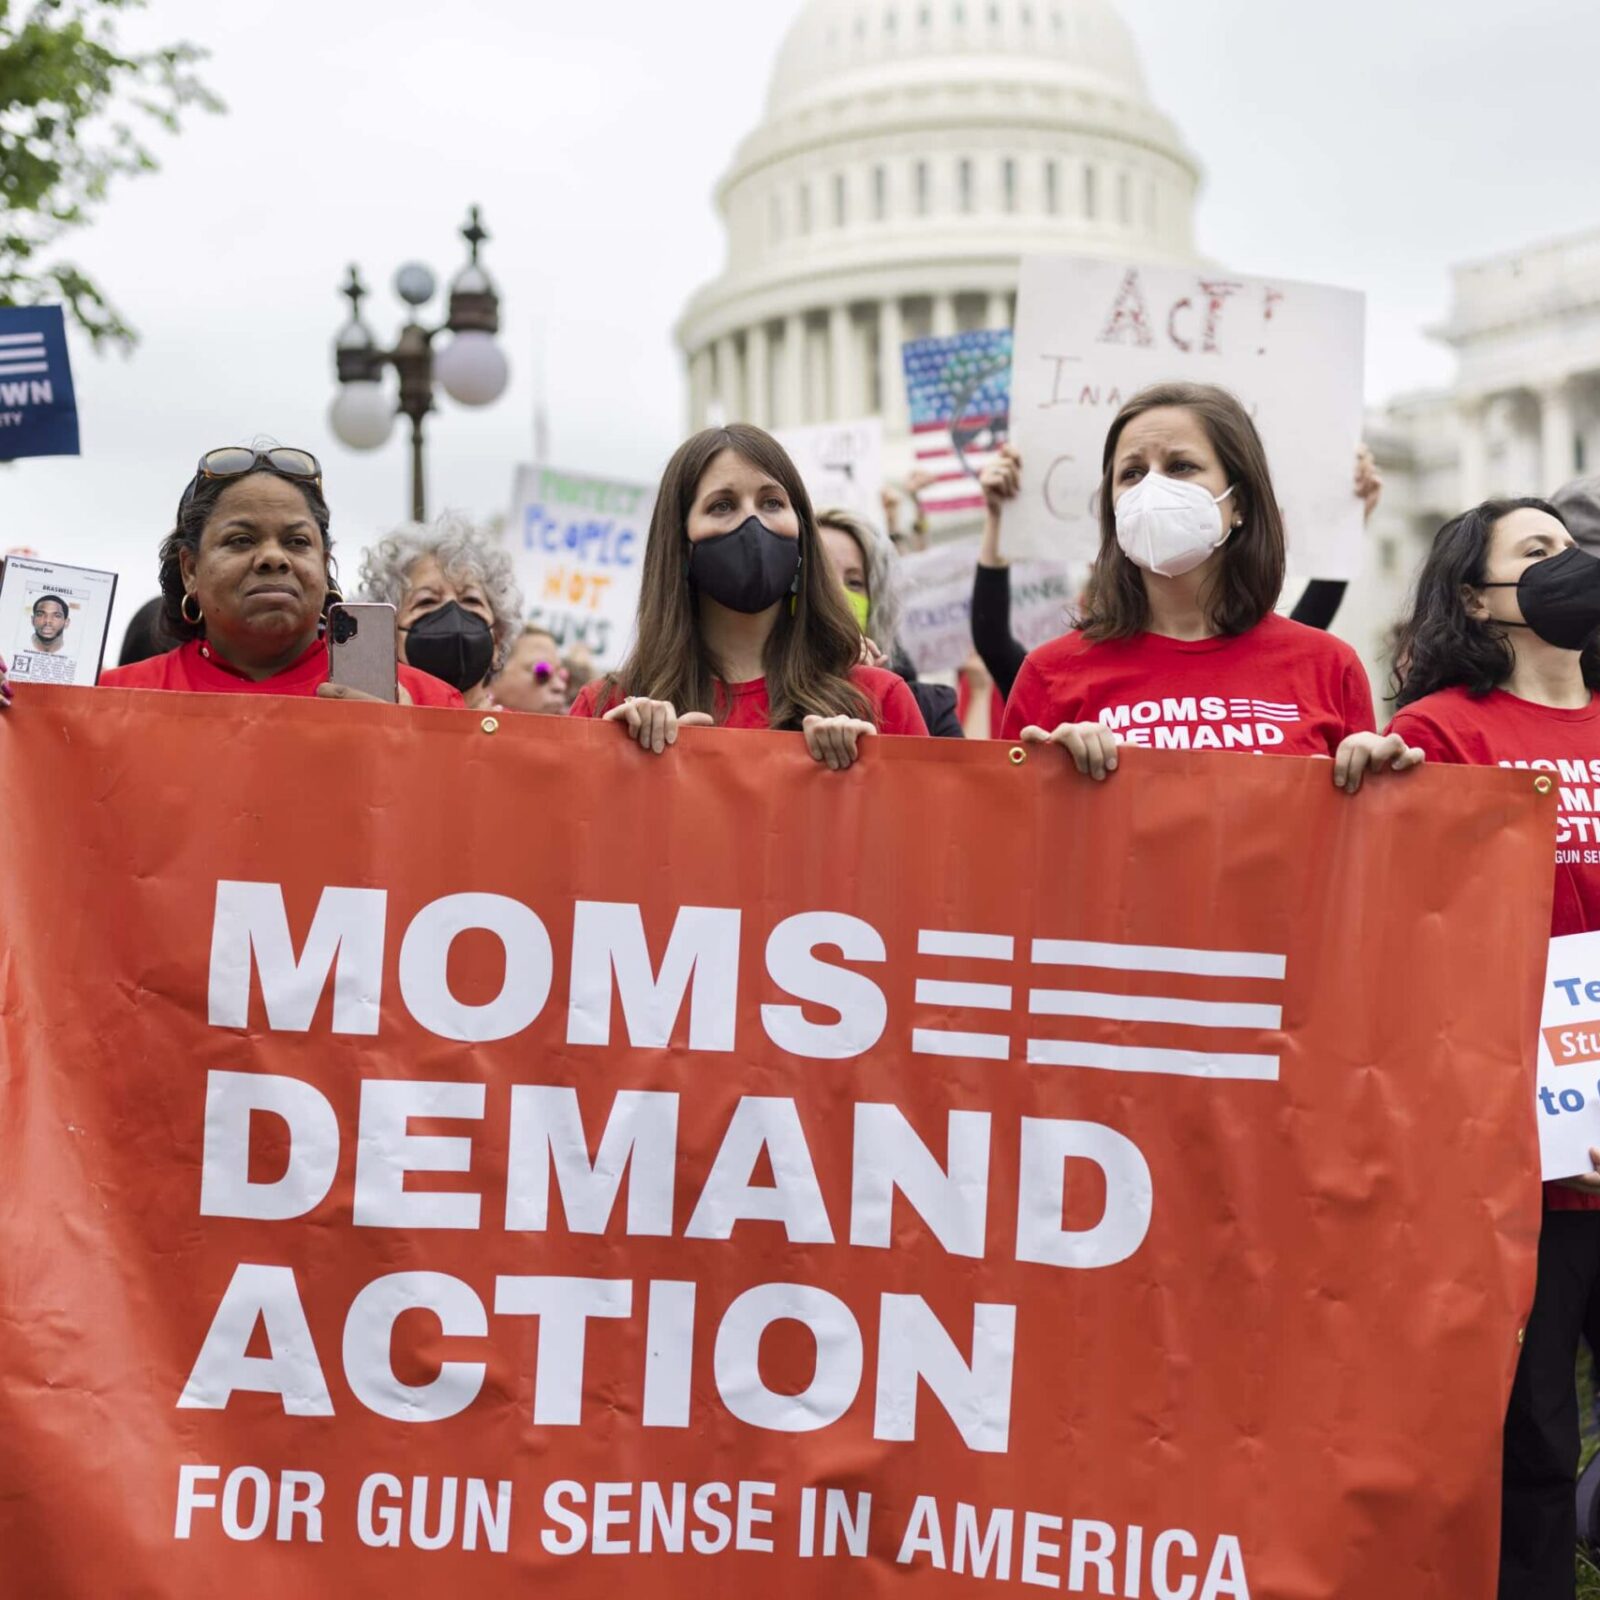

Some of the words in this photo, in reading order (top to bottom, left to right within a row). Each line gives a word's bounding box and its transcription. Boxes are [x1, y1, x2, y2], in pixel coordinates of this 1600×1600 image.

[42, 584, 73, 595] BRASWELL
[544, 567, 612, 614] NOT
[1099, 696, 1227, 730] MOMS
[1555, 850, 1580, 864] GUN
[208, 880, 888, 1059] MOMS
[1538, 1086, 1585, 1115] to
[200, 1070, 1153, 1269] DEMAND
[176, 1264, 1017, 1453] ACTION
[175, 1465, 325, 1542] FOR
[358, 1472, 513, 1553] GUN
[541, 1479, 776, 1556] SENSE
[800, 1487, 872, 1558] IN
[897, 1495, 1250, 1600] AMERICA
